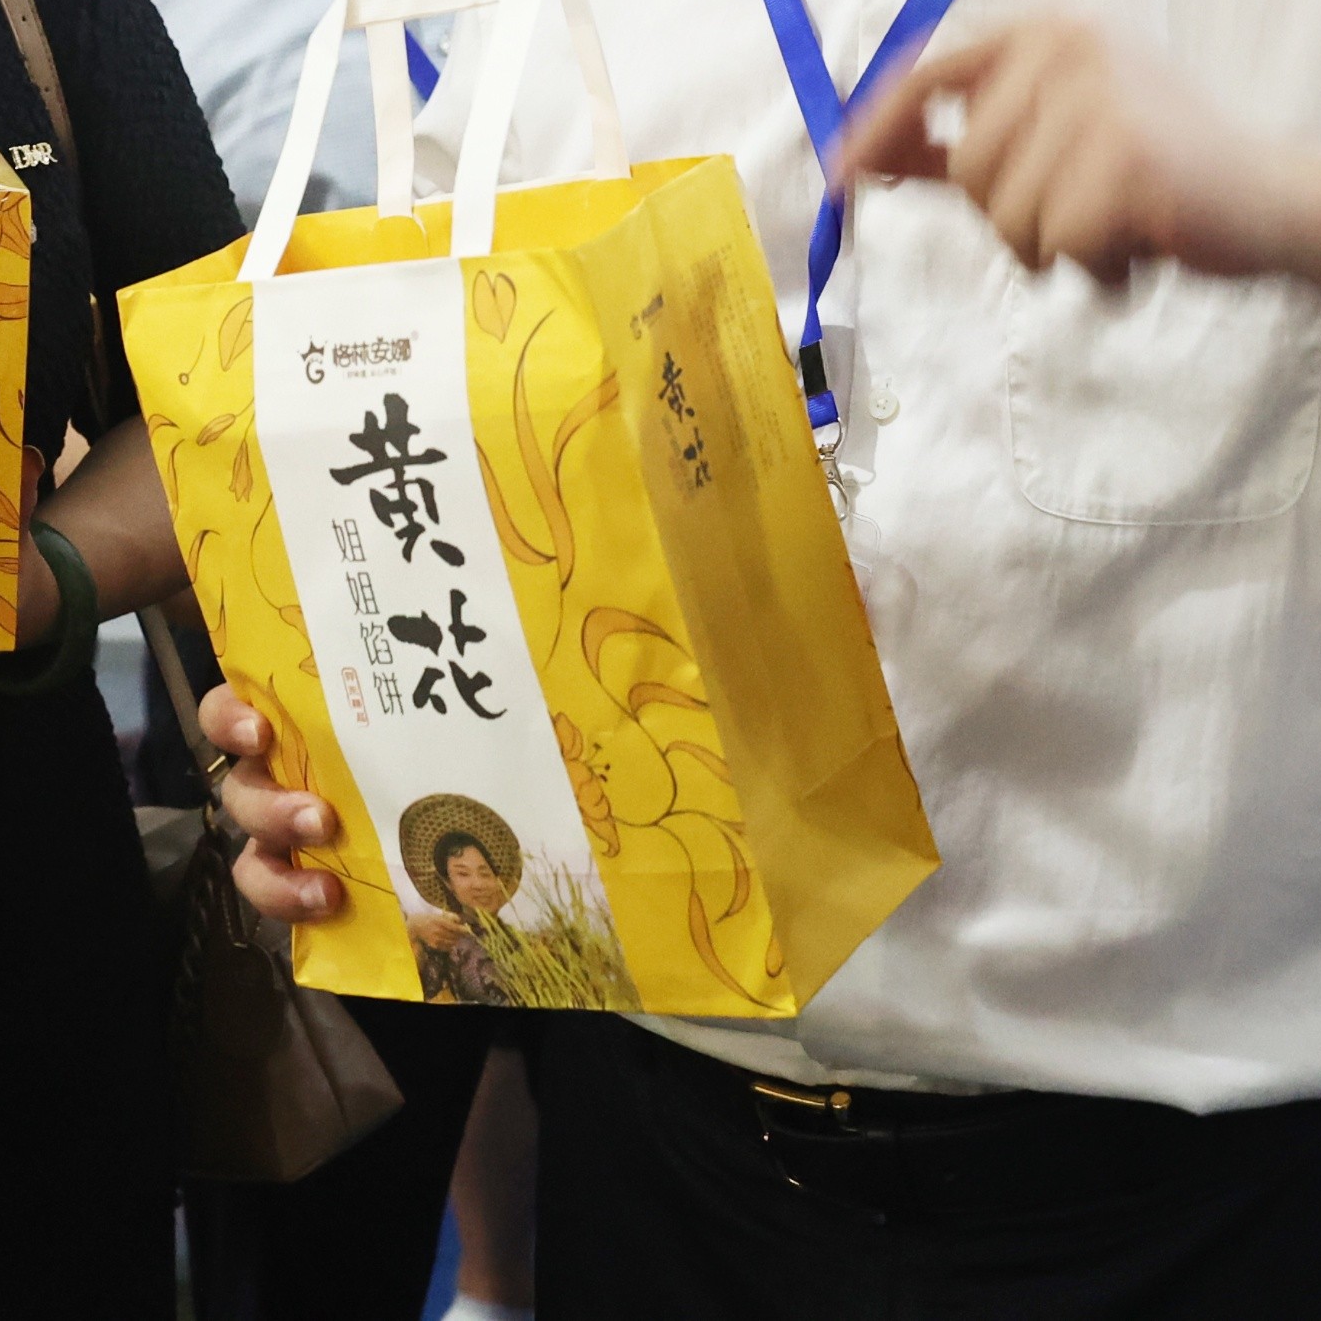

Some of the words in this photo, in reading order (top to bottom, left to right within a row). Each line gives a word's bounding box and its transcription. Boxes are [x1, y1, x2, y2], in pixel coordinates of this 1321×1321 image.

[331, 336, 412, 368] 格林安娜
[330, 393, 508, 721] 黄花
[332, 519, 405, 717] 姐姐馅饼
